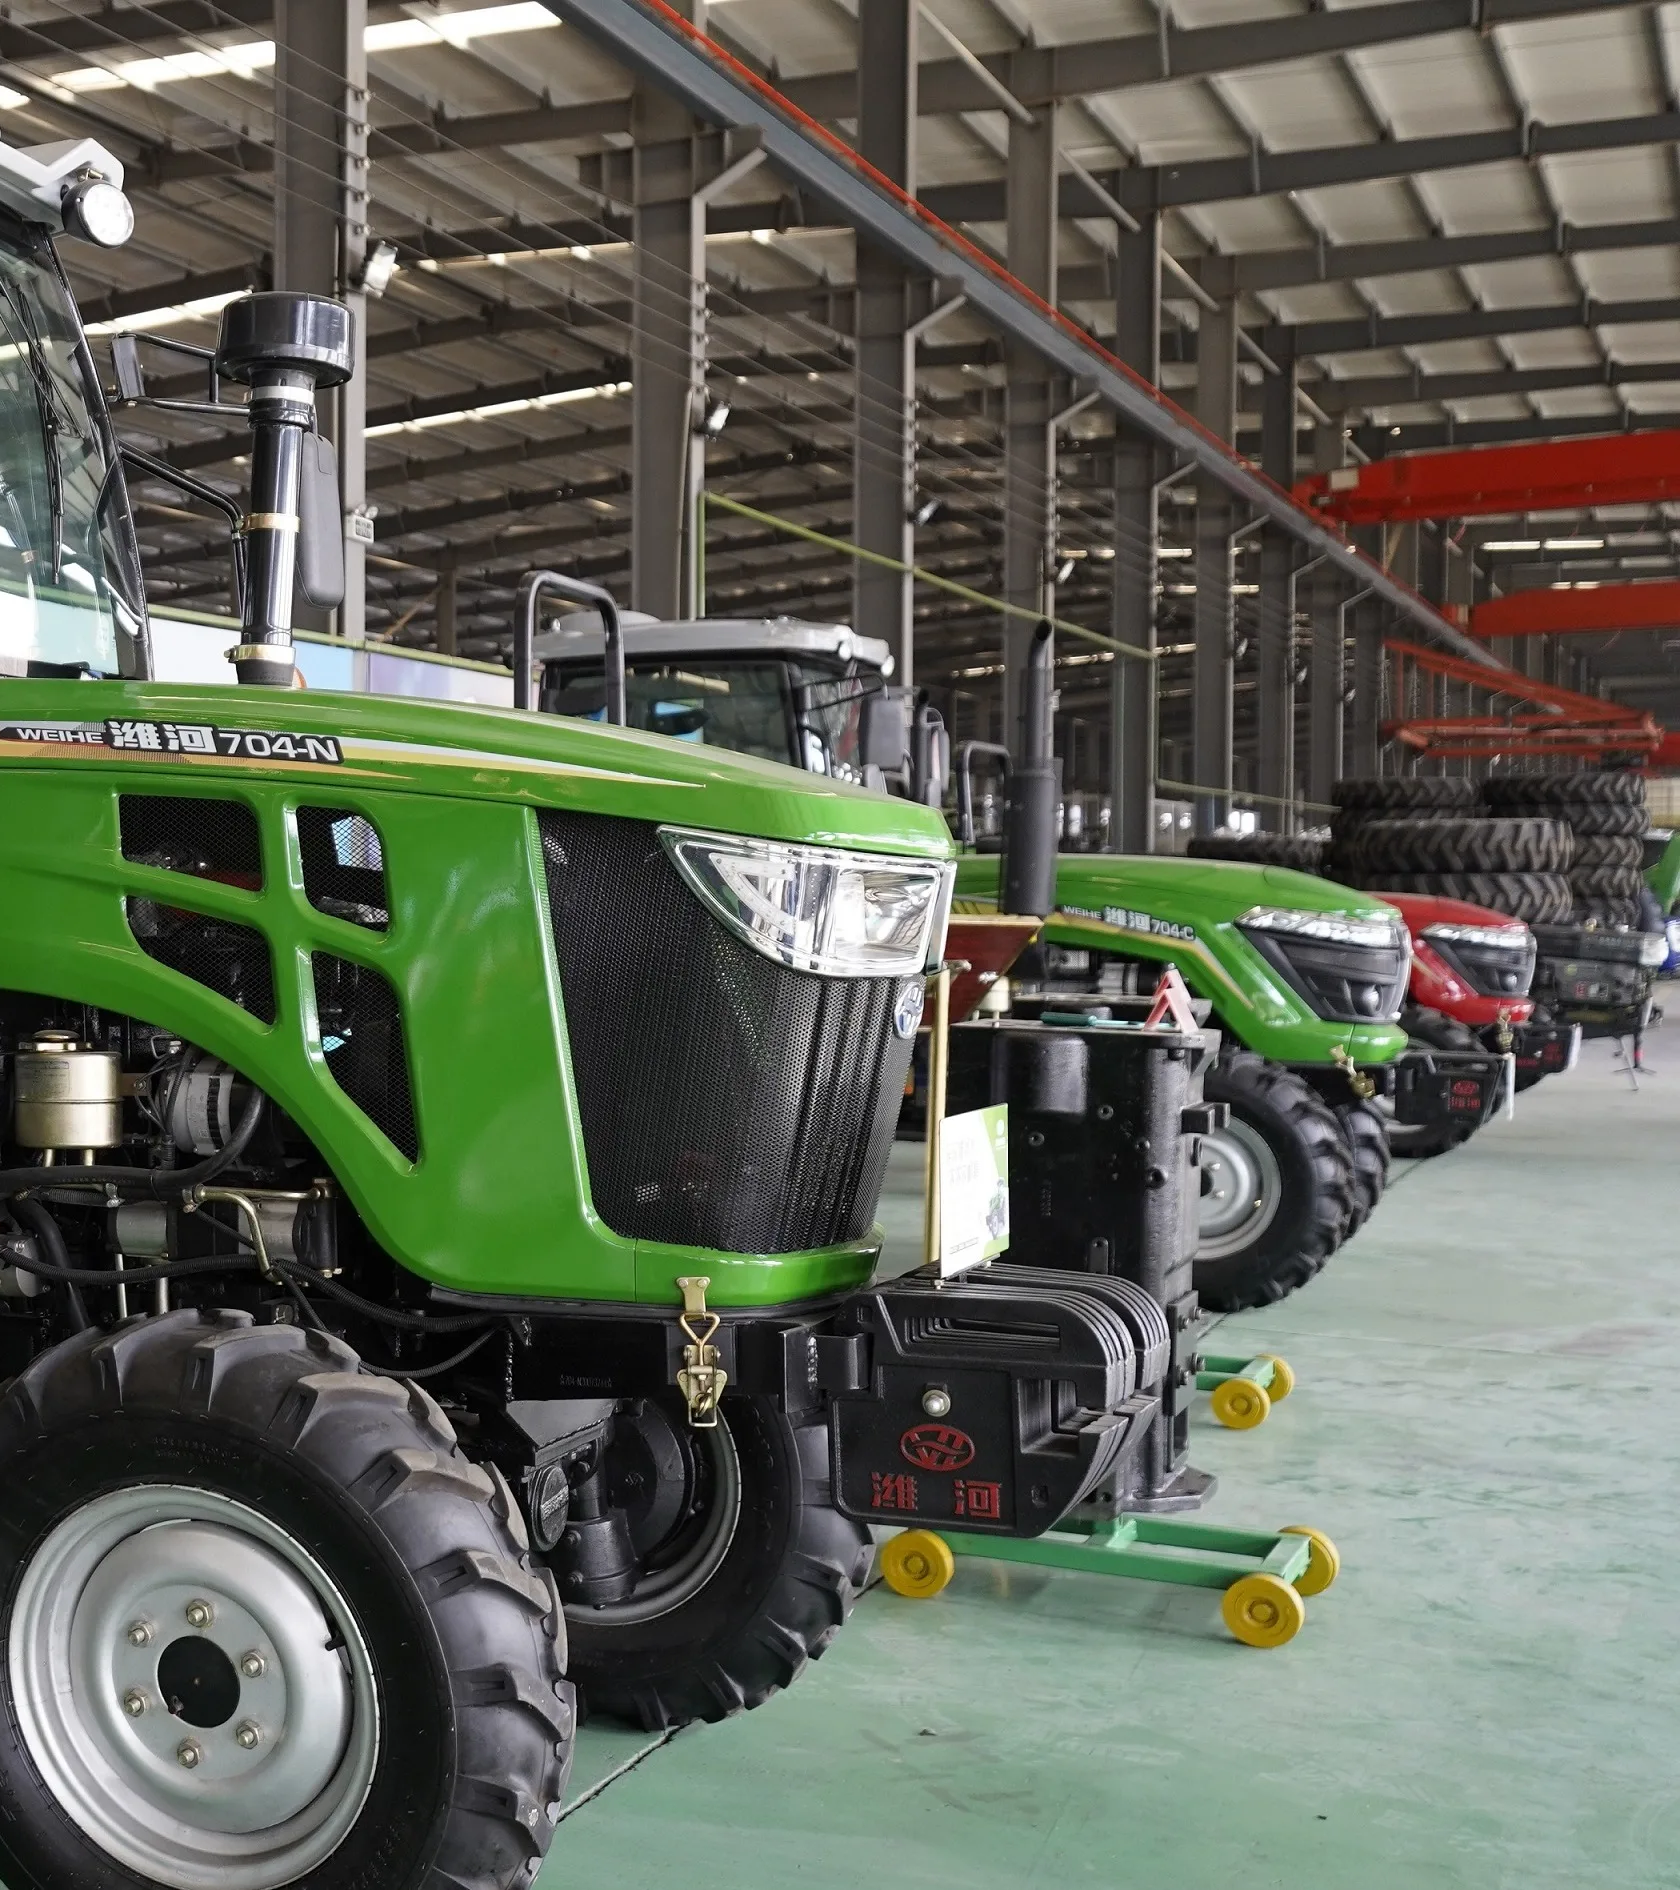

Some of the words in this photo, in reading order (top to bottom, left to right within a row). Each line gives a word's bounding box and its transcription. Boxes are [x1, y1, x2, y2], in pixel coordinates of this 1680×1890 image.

[17, 728, 105, 744] WEIHE
[109, 720, 217, 753] 潍河
[219, 733, 339, 763] 704-N
[1063, 904, 1101, 919] WEIHE
[1104, 905, 1151, 932] 潍河
[1151, 918, 1195, 940] 704-C
[871, 1471, 1003, 1519] 潍河
